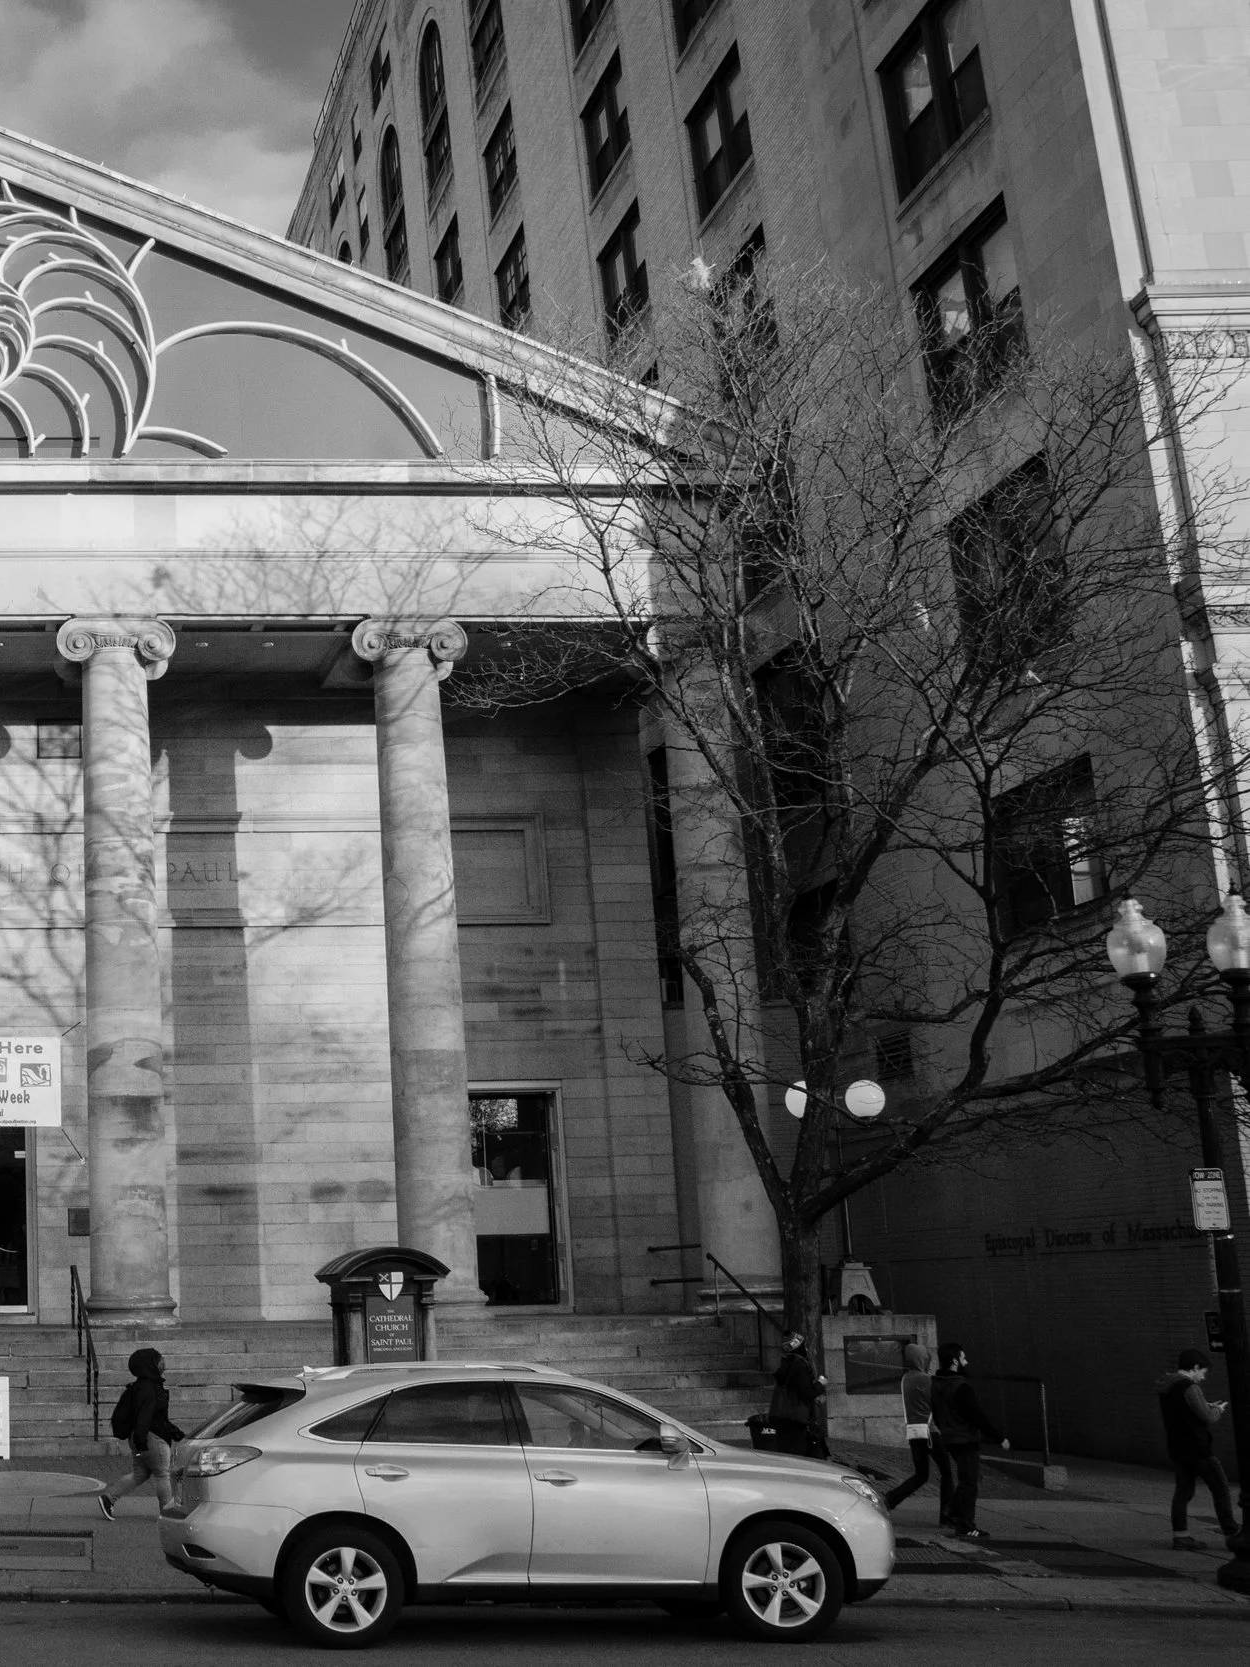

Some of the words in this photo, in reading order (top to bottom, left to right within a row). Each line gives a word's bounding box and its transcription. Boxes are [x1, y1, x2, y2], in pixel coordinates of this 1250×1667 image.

[164, 861, 239, 883] PAUL
[1193, 1172, 1205, 1180] TOW
[1207, 1171, 1221, 1179] ZONE
[985, 1228, 1036, 1256] Episcopal
[1045, 1227, 1092, 1248] Diocese
[1102, 1222, 1117, 1244] of
[1127, 1217, 1204, 1243] Massachus
[369, 1315, 414, 1323] CATHEDRAL
[370, 1338, 393, 1346] SAINT
